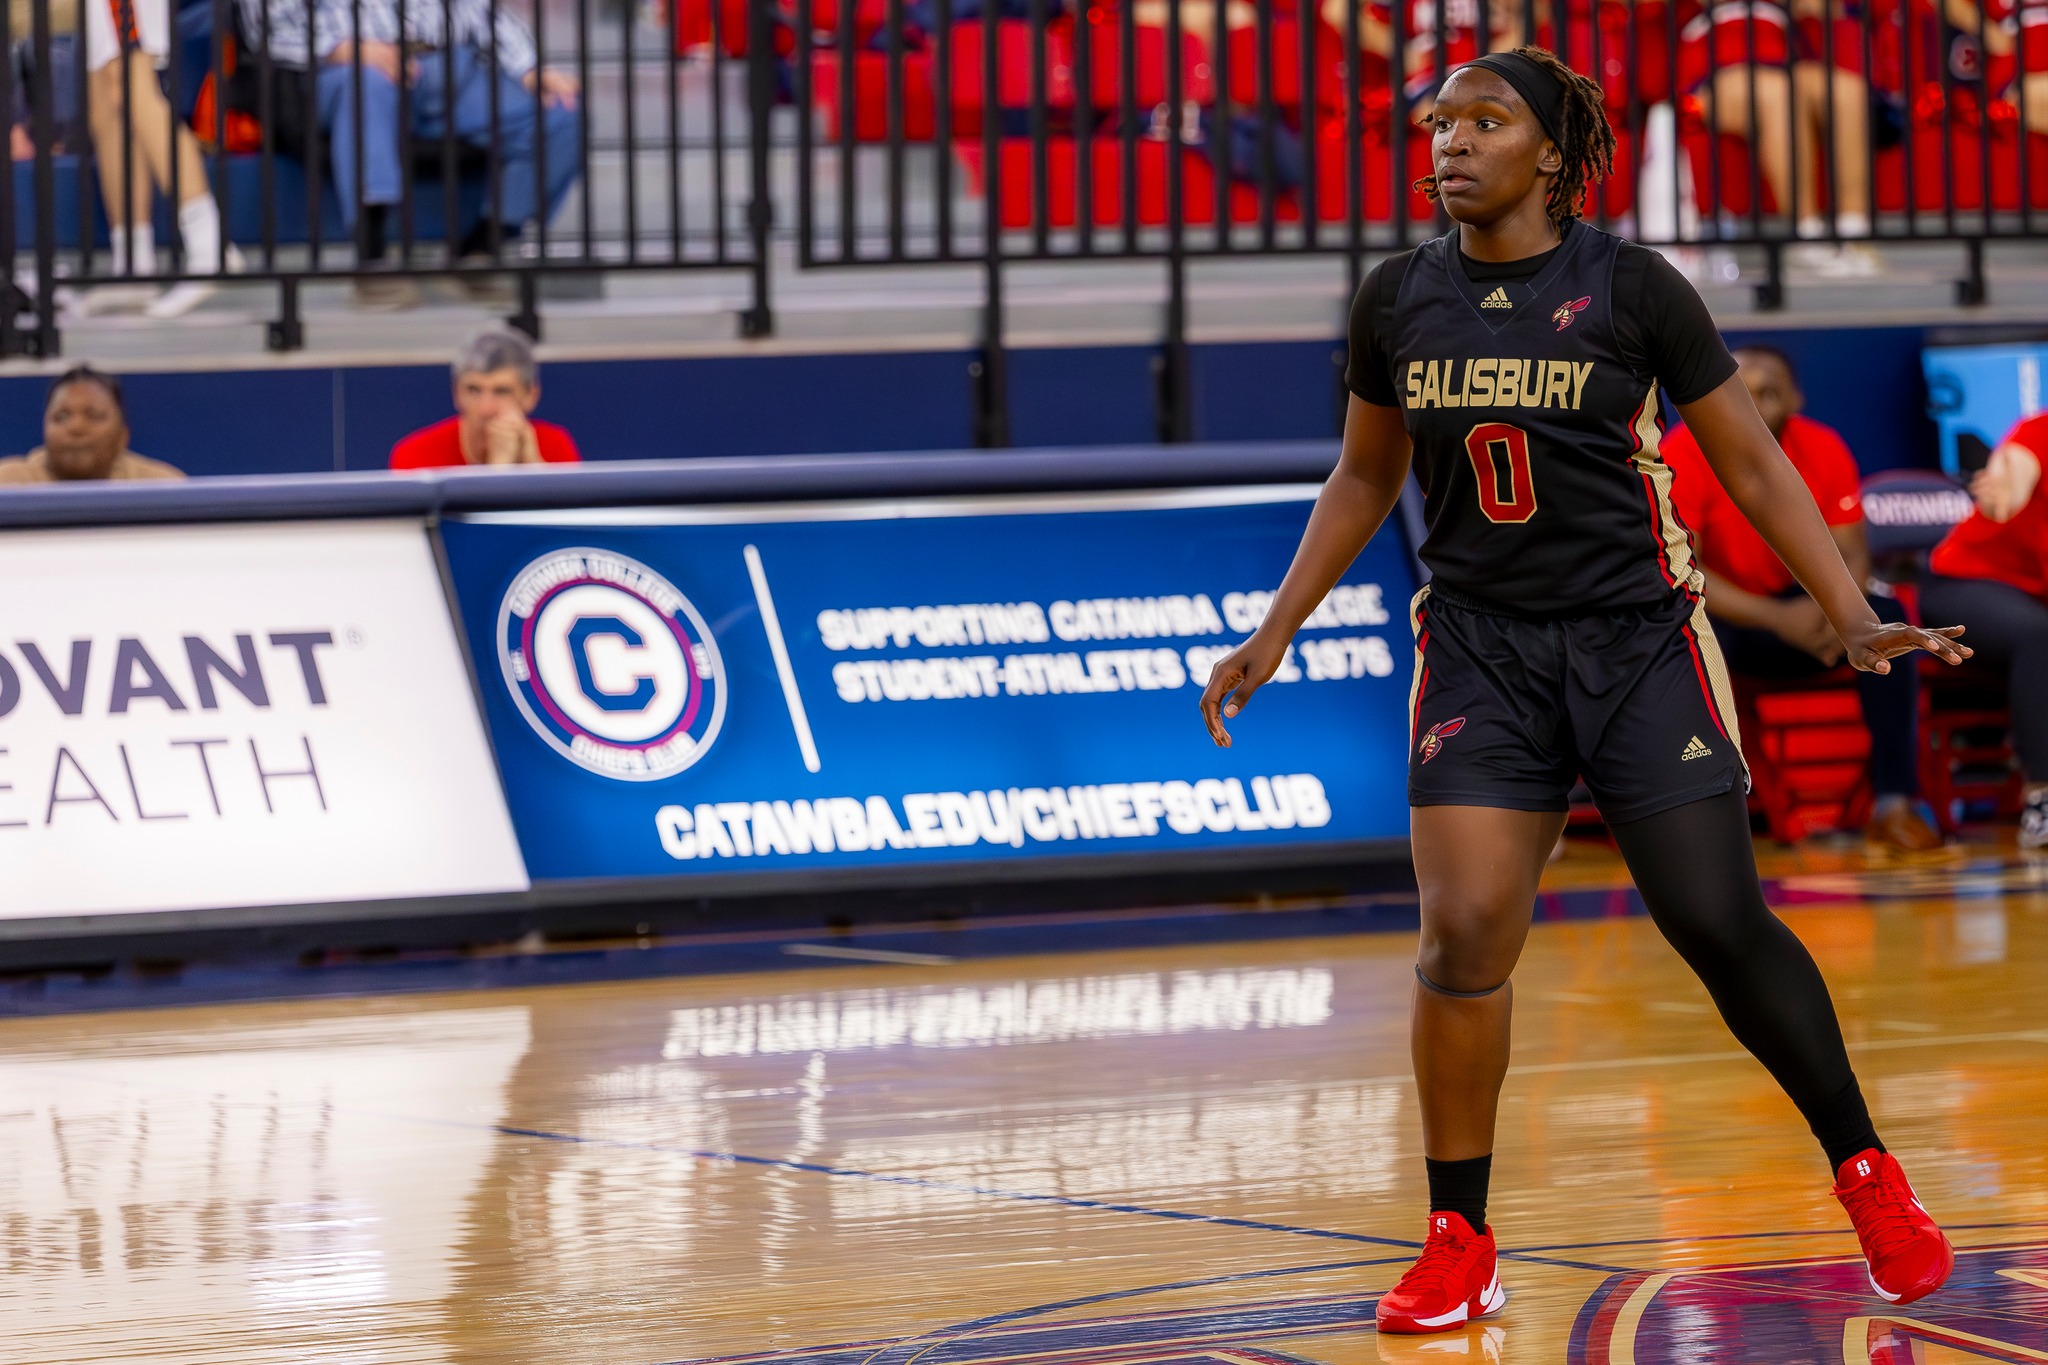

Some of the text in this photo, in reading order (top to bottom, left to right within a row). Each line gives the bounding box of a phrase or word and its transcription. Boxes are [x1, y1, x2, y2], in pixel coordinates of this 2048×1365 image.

[1480, 300, 1513, 309] adidas
[1406, 358, 1595, 410] SALISBURY
[1464, 422, 1538, 524] 0
[817, 583, 1390, 651] SUPPORTING CATAWBA COEGE
[567, 615, 656, 711] C
[832, 647, 1186, 703] STUDENT-ATHLETES
[1301, 635, 1394, 681] 1976
[1681, 748, 1713, 761] adidas
[654, 773, 1332, 860] CATAWBA.EDU/CHIEFSCLUB
